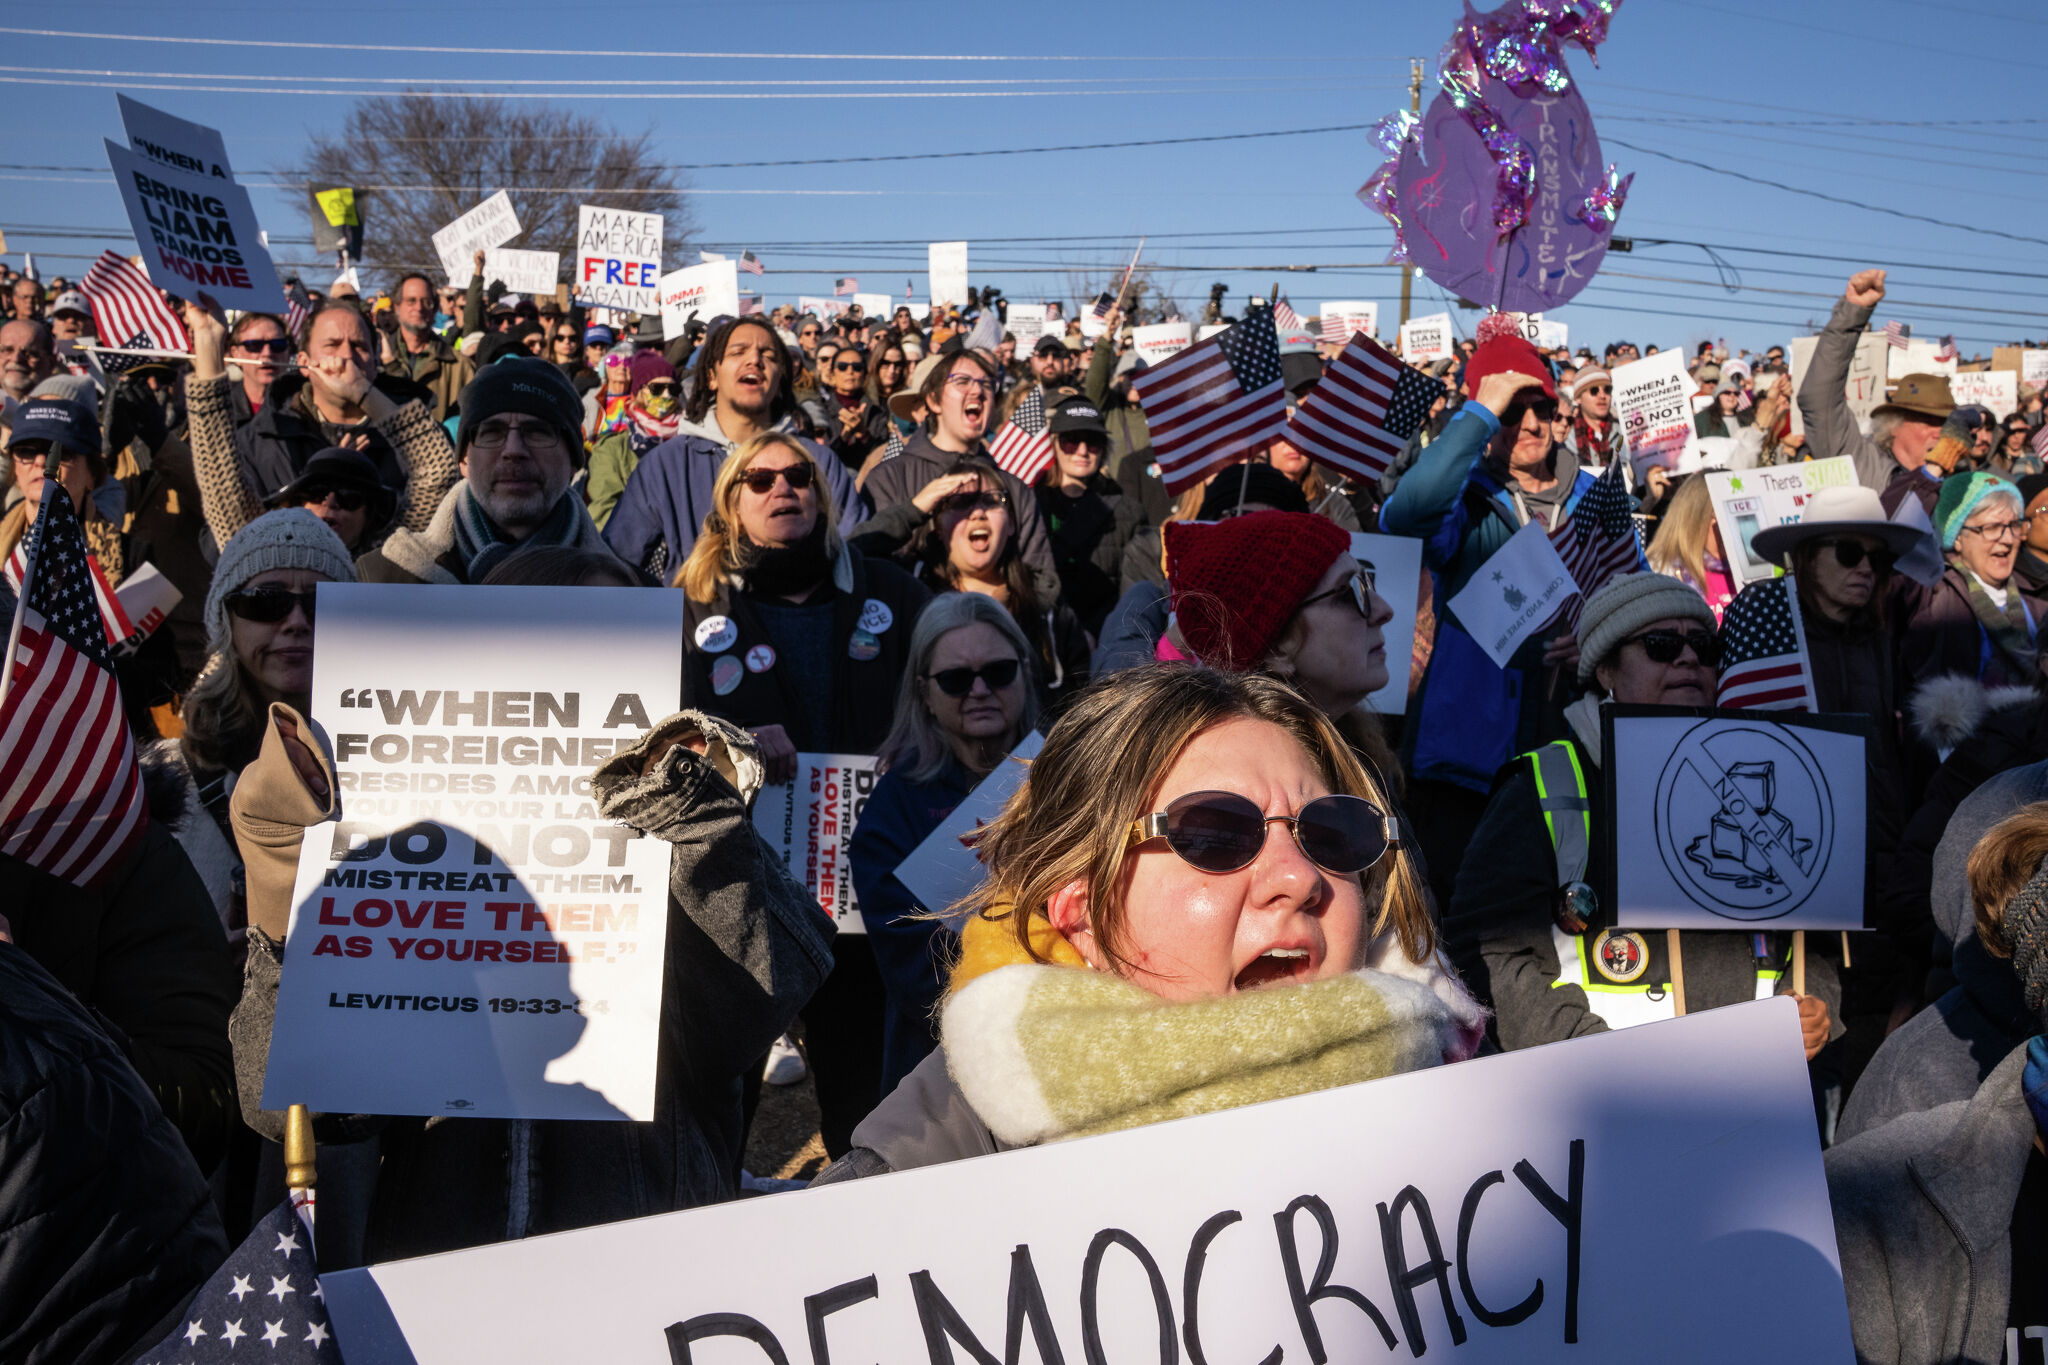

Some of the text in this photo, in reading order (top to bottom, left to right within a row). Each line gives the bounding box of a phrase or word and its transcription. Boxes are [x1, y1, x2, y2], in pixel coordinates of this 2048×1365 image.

[134, 135, 204, 174] “WHEN
[211, 164, 227, 179] A
[132, 170, 228, 219] BRING
[1532, 98, 1560, 290] TRANSMUTE!
[139, 195, 238, 247] LIAM
[590, 211, 657, 237] MAKE
[150, 226, 244, 266] RAMOS
[580, 230, 662, 260] AMERICA
[158, 246, 253, 289] HOME
[584, 257, 657, 288] FREE
[580, 284, 649, 308] AGAIN
[1409, 334, 1441, 344] LIAM
[1670, 375, 1680, 383] A
[1620, 384, 1682, 408] FOREIGNER
[1624, 416, 1644, 430] DO
[1649, 405, 1684, 422] NOT
[1628, 422, 1688, 446] LOVE THEM
[1760, 474, 1802, 492] There's
[1734, 502, 1751, 512] ICE
[1793, 495, 1805, 507] IN
[863, 612, 890, 629] ICE
[340, 688, 652, 729] “WHEN A
[335, 771, 594, 797] RESIDES AMO
[1713, 777, 1745, 815] NO
[336, 798, 604, 820] YOU IN YOUR LA
[823, 767, 838, 836] LOVE
[839, 768, 853, 860] MISTREAT
[329, 821, 643, 867] DO NOT
[806, 766, 821, 896] AS YOURSEL
[1749, 821, 1780, 858] ICE
[323, 868, 643, 893] MISTREAT THEM.
[318, 897, 639, 932] LOVE THEM
[312, 934, 373, 958] AS
[329, 992, 479, 1013] LEVITICUS
